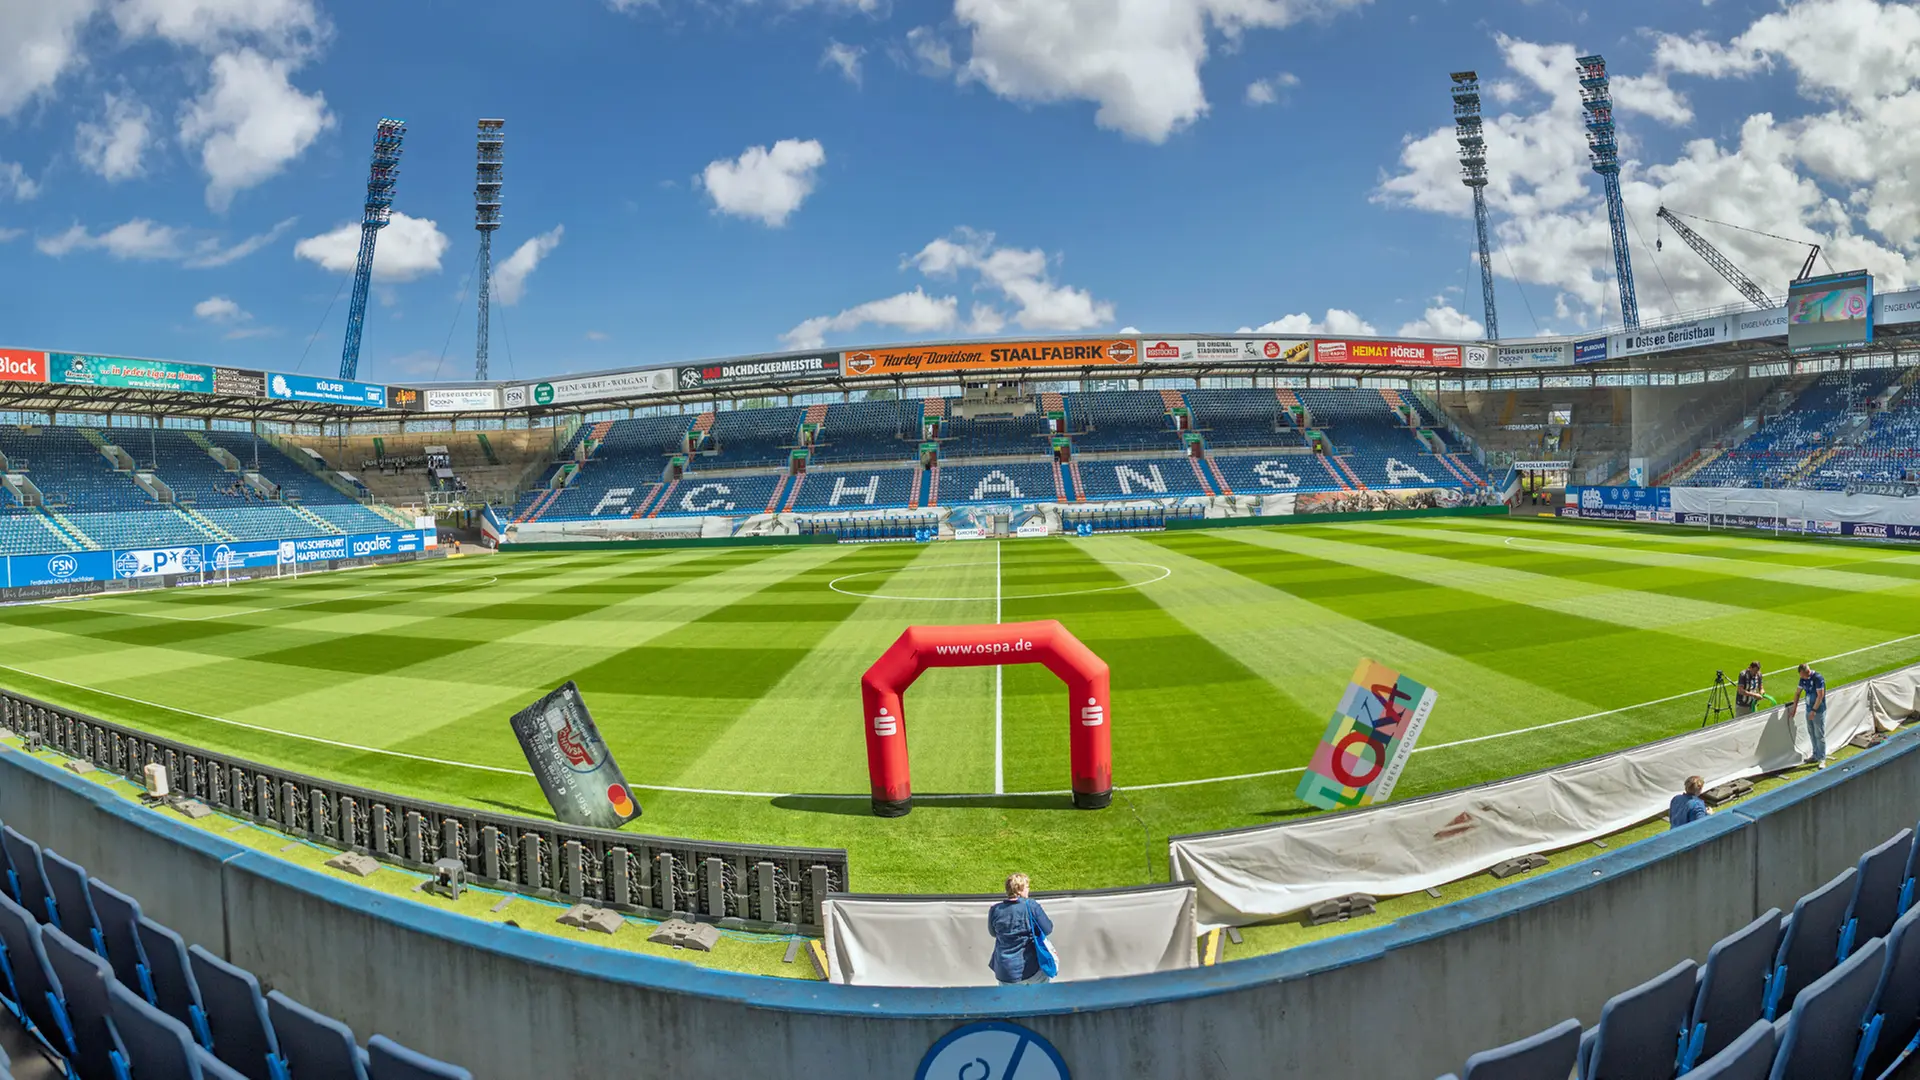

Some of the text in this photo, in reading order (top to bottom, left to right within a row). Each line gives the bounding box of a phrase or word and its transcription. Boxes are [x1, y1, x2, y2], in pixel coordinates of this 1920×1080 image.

[1636, 334, 1665, 348] Ostsee
[1668, 326, 1715, 344] Gerüstbau
[1352, 345, 1425, 359] HEIMAT HÖREN!
[1469, 352, 1485, 361] FSN
[1498, 346, 1562, 355] Fliesenservice
[112, 365, 121, 374] in
[122, 366, 145, 378] jeder
[147, 369, 165, 379] Liga
[722, 358, 822, 377] DACHDECKERMEISTER
[316, 380, 344, 392] KÜLPER
[611, 376, 648, 386] WOLGAST
[429, 391, 492, 399] Fliesenservice
[507, 393, 522, 401] FSN
[1854, 525, 1887, 534] ARTEK
[1894, 525, 1908, 535] Wir
[296, 541, 307, 549] WG
[353, 535, 391, 555] rogatec
[297, 548, 346, 561] HAFEN ROSTOCK
[52, 559, 73, 571] FSN
[154, 552, 168, 572] P
[936, 638, 1033, 656] www.ospa.de
[536, 715, 591, 817] 2812 1965 0381 1954
[1380, 763, 1400, 797] LIEBEN
[557, 786, 567, 796] D
